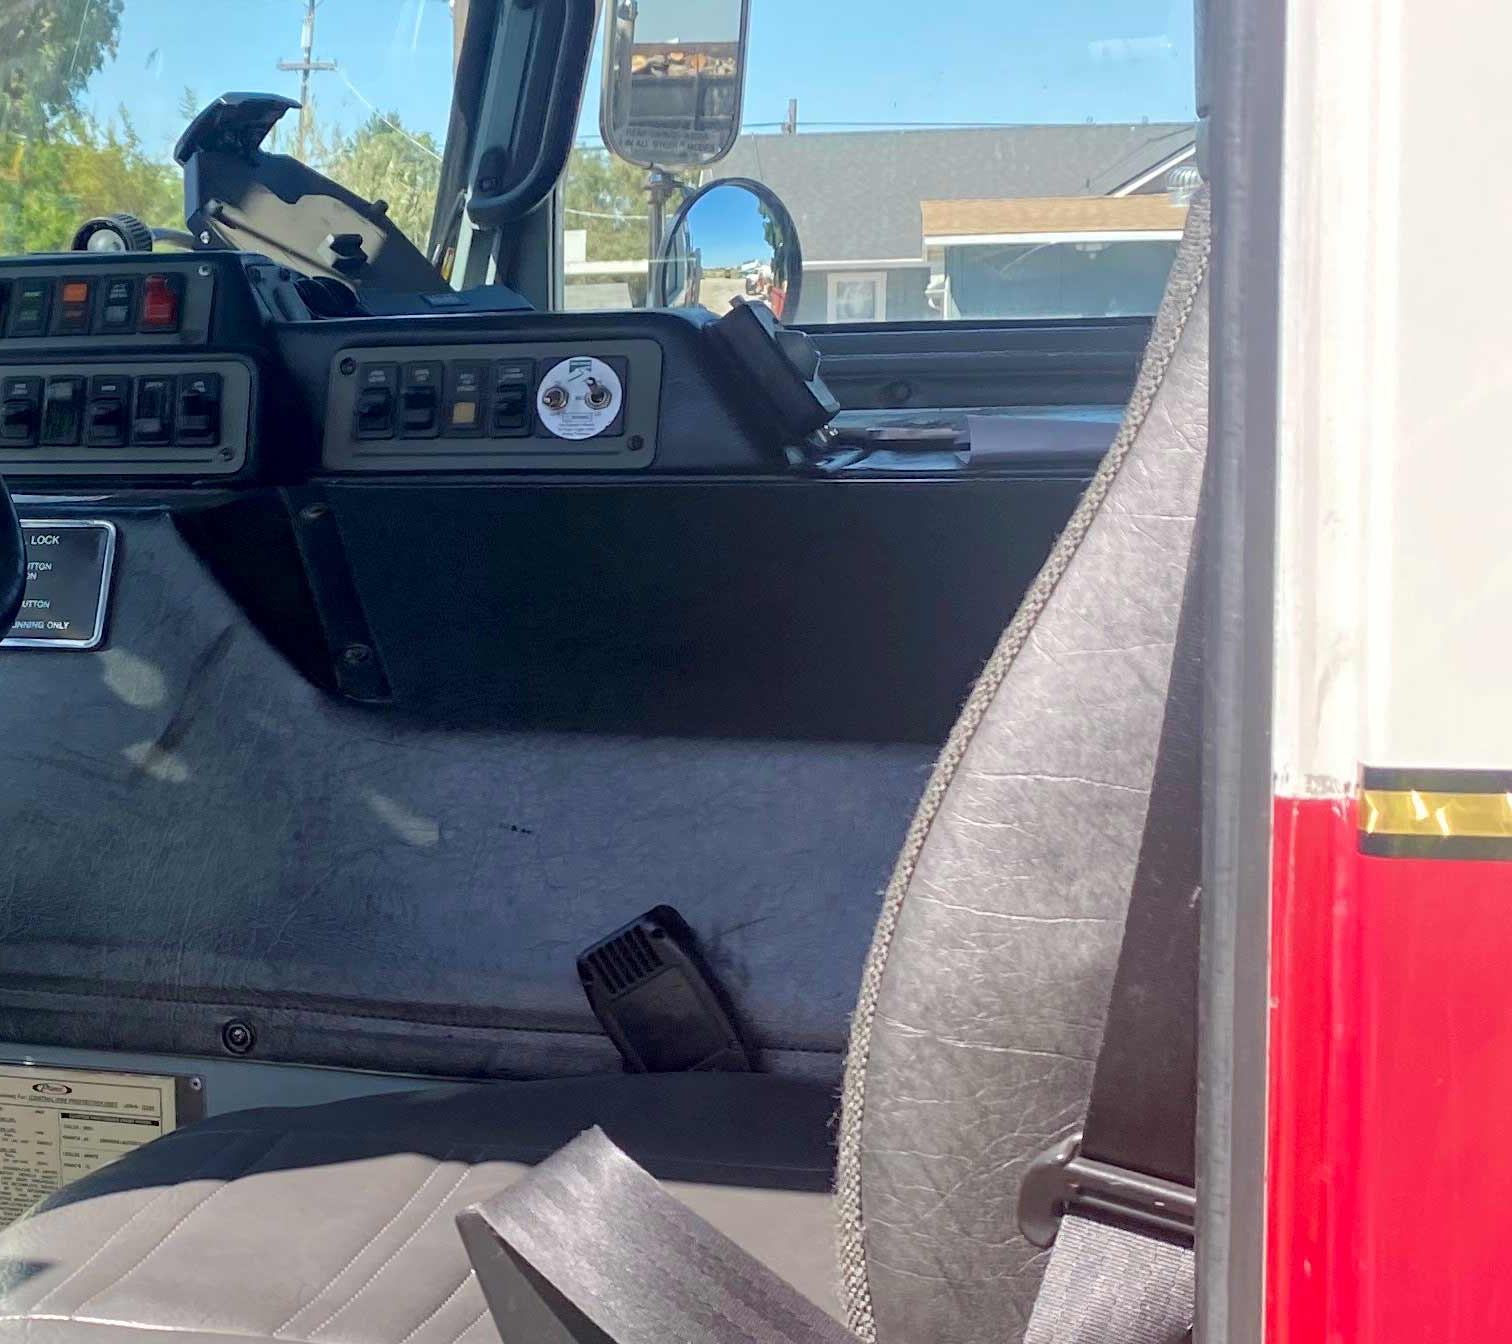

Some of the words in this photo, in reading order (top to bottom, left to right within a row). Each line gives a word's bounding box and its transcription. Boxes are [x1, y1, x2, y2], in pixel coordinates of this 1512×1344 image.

[30, 535, 60, 545] LOCK
[21, 599, 50, 609] UTTON
[46, 621, 70, 630] ONLY
